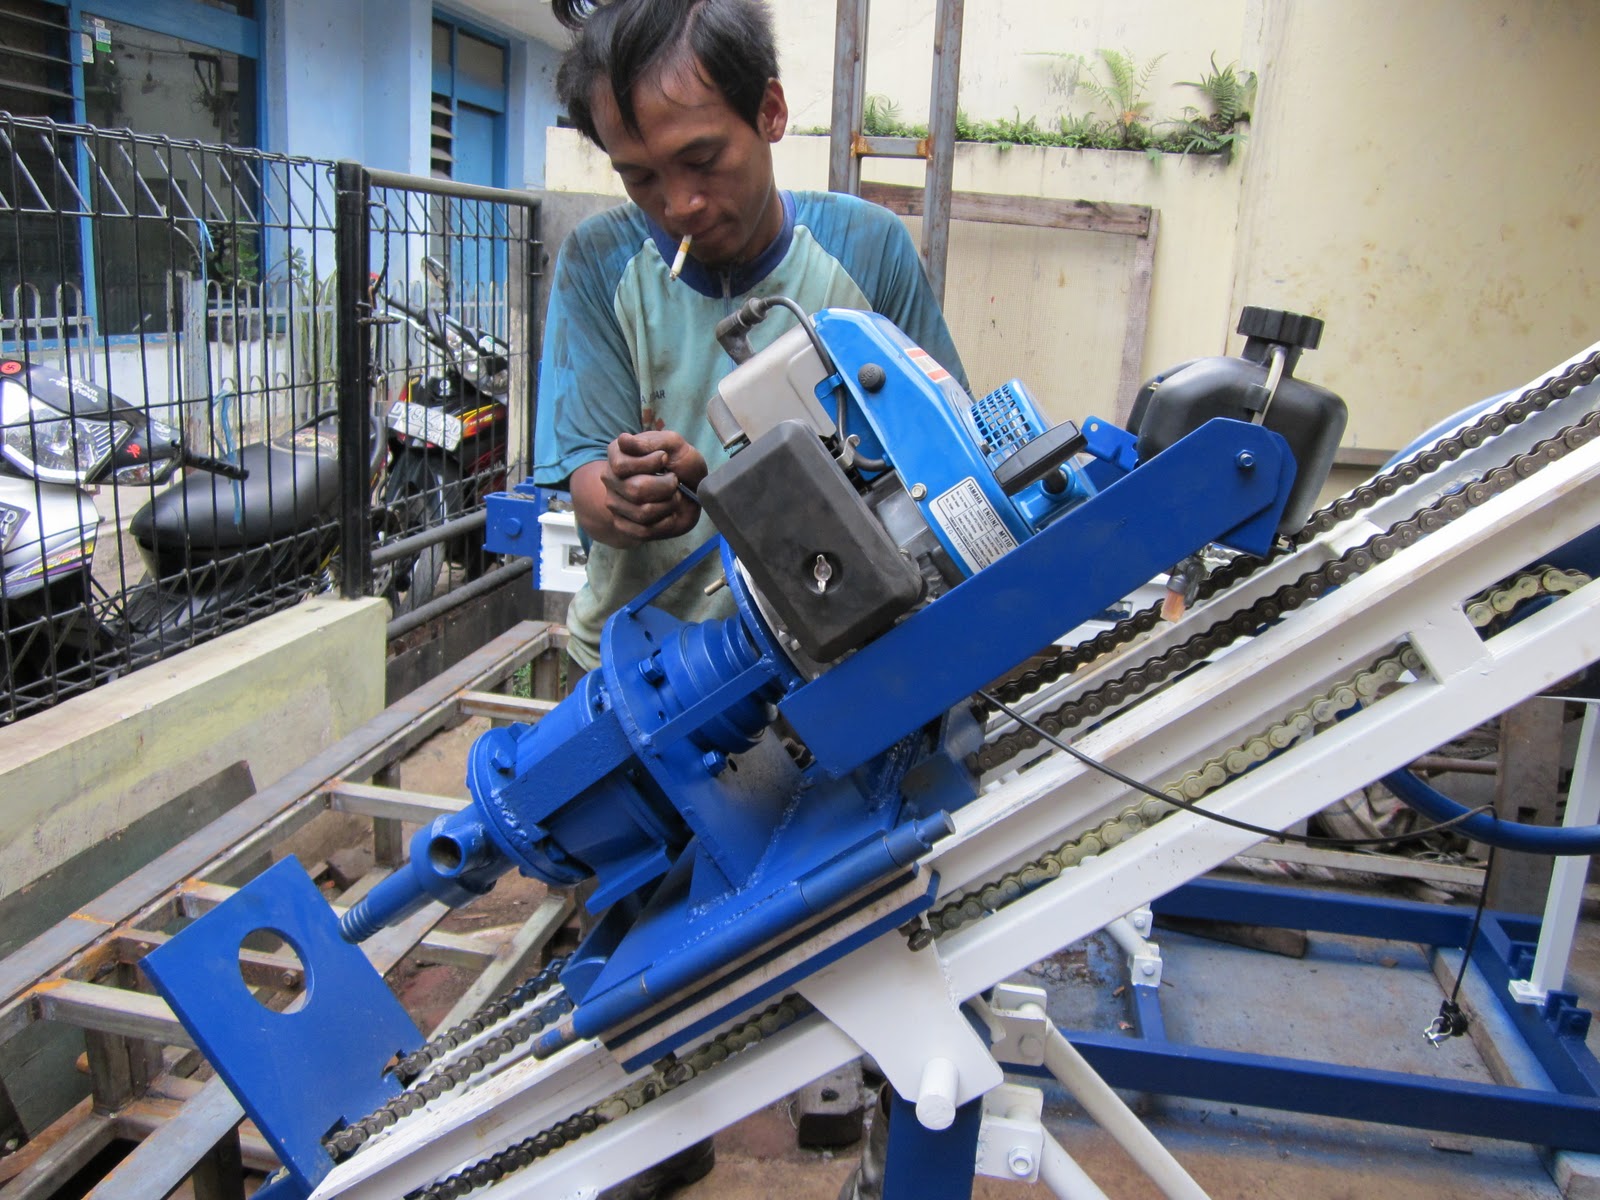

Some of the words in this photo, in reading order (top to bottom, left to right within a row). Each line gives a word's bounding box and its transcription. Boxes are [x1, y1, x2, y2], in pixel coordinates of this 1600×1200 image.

[860, 366, 876, 384] STOP
[966, 482, 983, 504] YAMAHA
[982, 507, 999, 528] ENGINE
[998, 530, 1013, 548] MT-110
